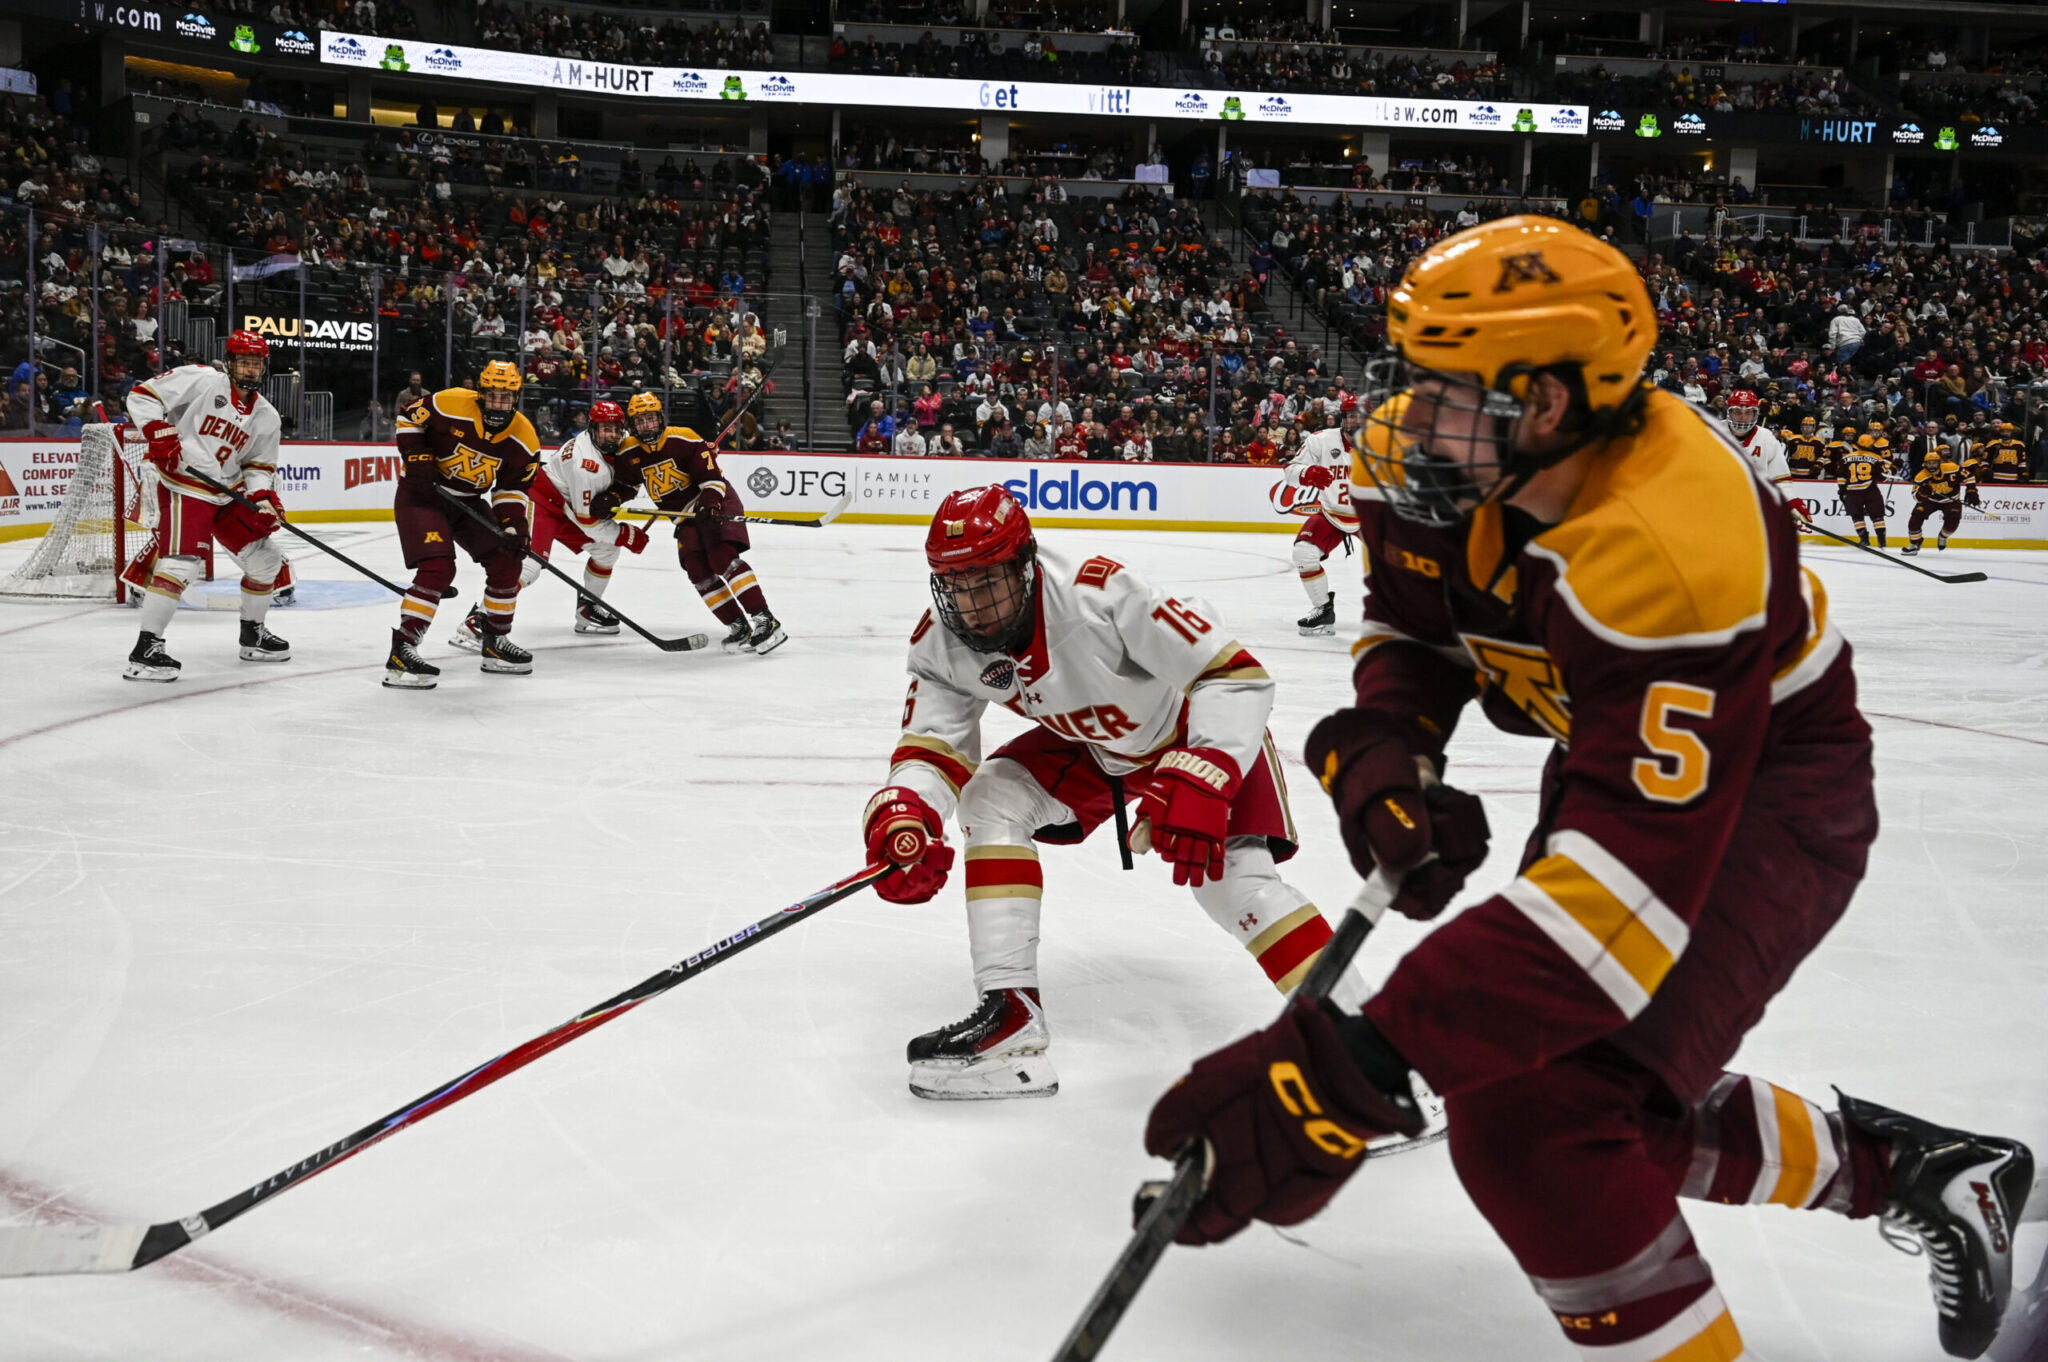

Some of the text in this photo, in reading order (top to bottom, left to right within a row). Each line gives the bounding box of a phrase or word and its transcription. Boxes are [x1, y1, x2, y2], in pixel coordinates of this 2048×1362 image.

[176, 20, 216, 36] McDivitt
[276, 38, 314, 50] McDivitt
[328, 44, 366, 56] McDivitt
[425, 56, 462, 68] McDivitt
[673, 80, 707, 89] McDivitt
[761, 83, 795, 92] McDivitt
[979, 82, 1018, 109] Get
[1175, 101, 1208, 110] McDivitt
[1259, 104, 1292, 113] McDivitt
[1469, 113, 1500, 122] McDivitt
[1550, 116, 1582, 125] McDivitt
[1593, 117, 1625, 127] McDivitt
[1674, 121, 1706, 130] McDivitt
[1893, 131, 1924, 139] McDivitt
[1971, 134, 2002, 143] McDivitt
[305, 318, 374, 342] DAVIS
[340, 341, 373, 351] Experts
[1751, 445, 1762, 458] A
[32, 452, 81, 464] ELEVAT
[276, 464, 321, 481] ntum
[344, 455, 401, 491] DENV
[864, 471, 932, 484] FAMILY
[1331, 465, 1352, 481] DEN
[1849, 462, 1872, 483] 19
[282, 482, 309, 492] IBER
[780, 471, 846, 498] JFG
[1002, 468, 1158, 512] slalom
[24, 485, 48, 497] ALL
[864, 487, 931, 500] OFFICE
[582, 490, 592, 507] 9
[1993, 499, 2046, 511] CRICKET
[1151, 597, 1213, 646] 16
[1631, 680, 1716, 804] 5
[889, 803, 908, 813] 16
[686, 922, 762, 969] BAUER
[252, 1138, 350, 1197] FLYLITE
